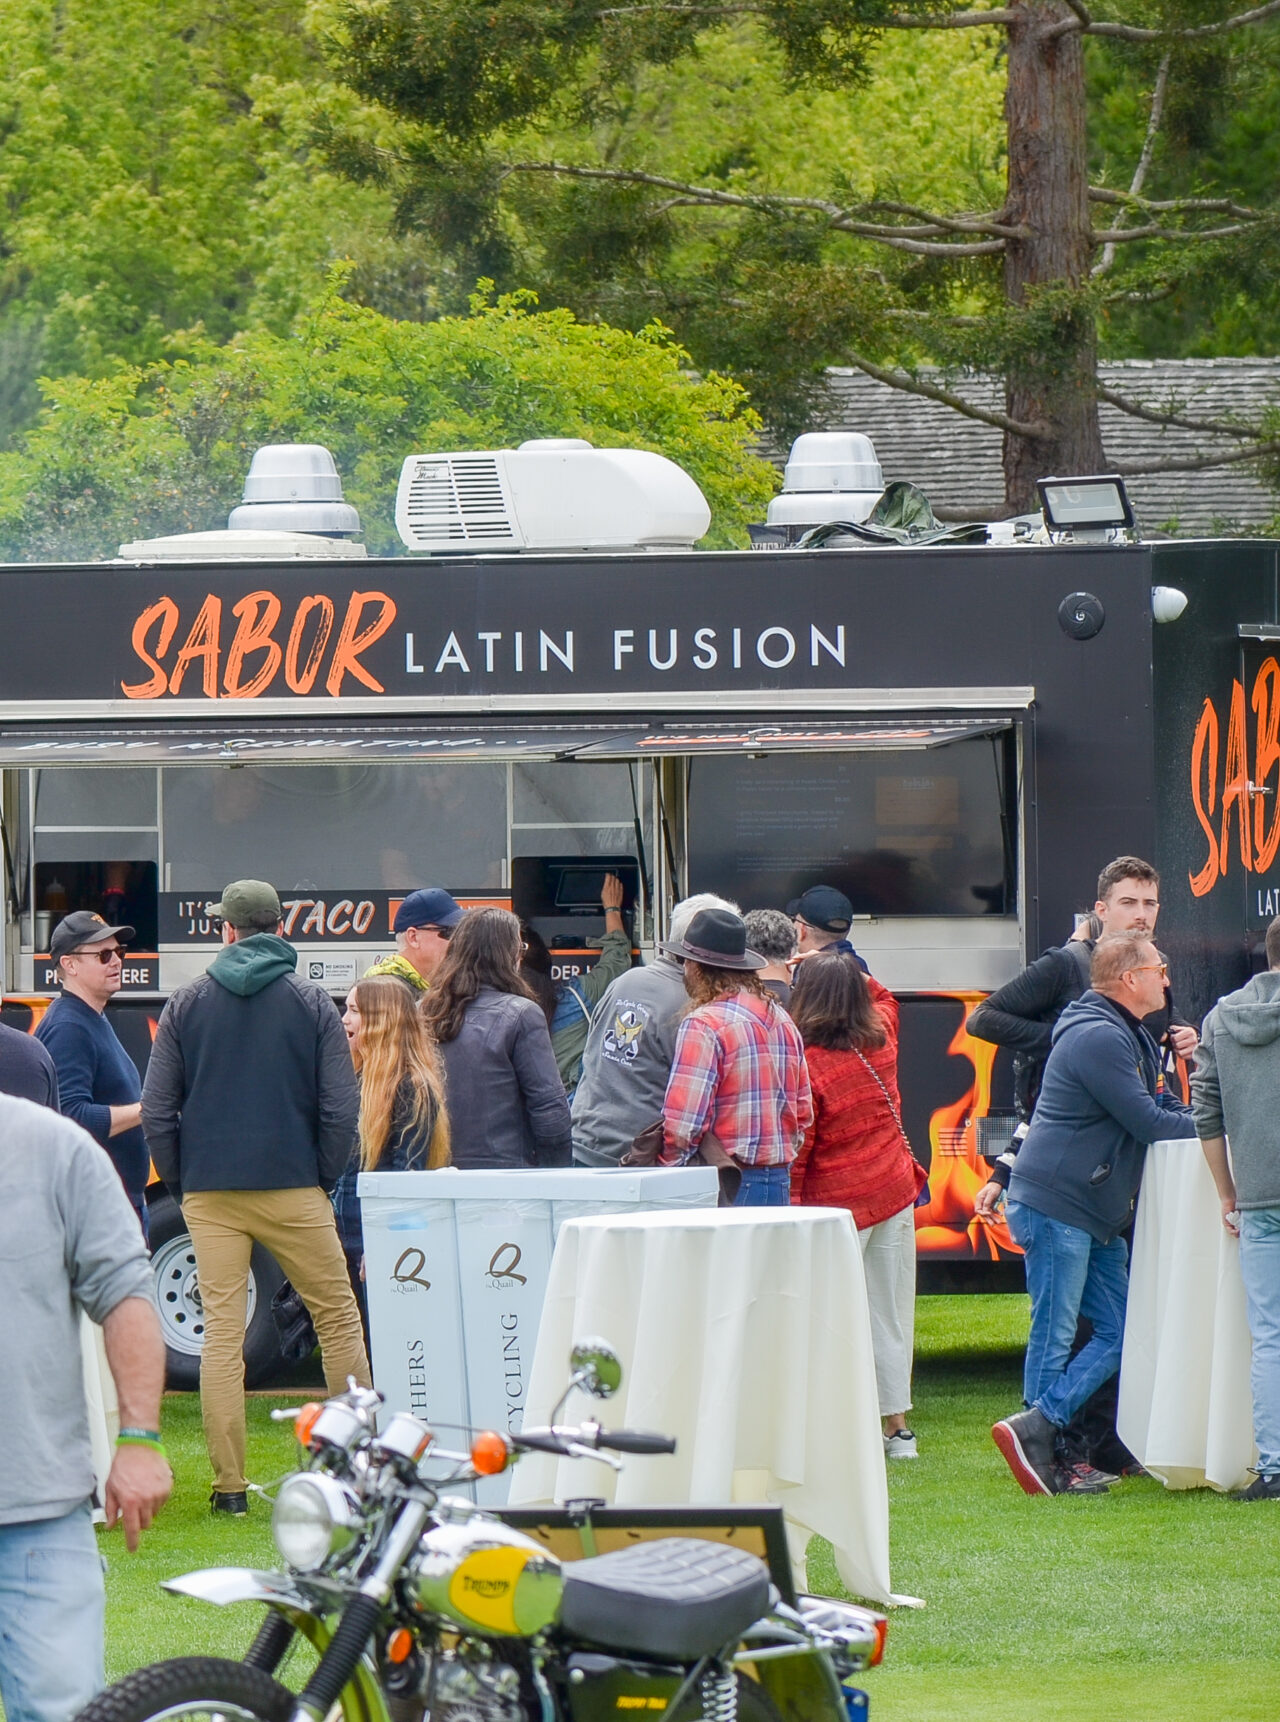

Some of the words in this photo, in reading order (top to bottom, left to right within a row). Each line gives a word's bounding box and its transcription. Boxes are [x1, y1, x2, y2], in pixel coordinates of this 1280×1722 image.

[120, 590, 397, 699] SABOR
[406, 630, 574, 674] LATIN
[614, 625, 847, 671] FUSION
[282, 899, 376, 936] TACO
[121, 968, 150, 984] ERE
[551, 965, 582, 980] DER
[390, 1247, 431, 1291] Q
[485, 1243, 527, 1286] Q
[397, 1283, 418, 1295] Quail
[492, 1279, 513, 1291] Quail
[500, 1312, 524, 1435] CYCLING
